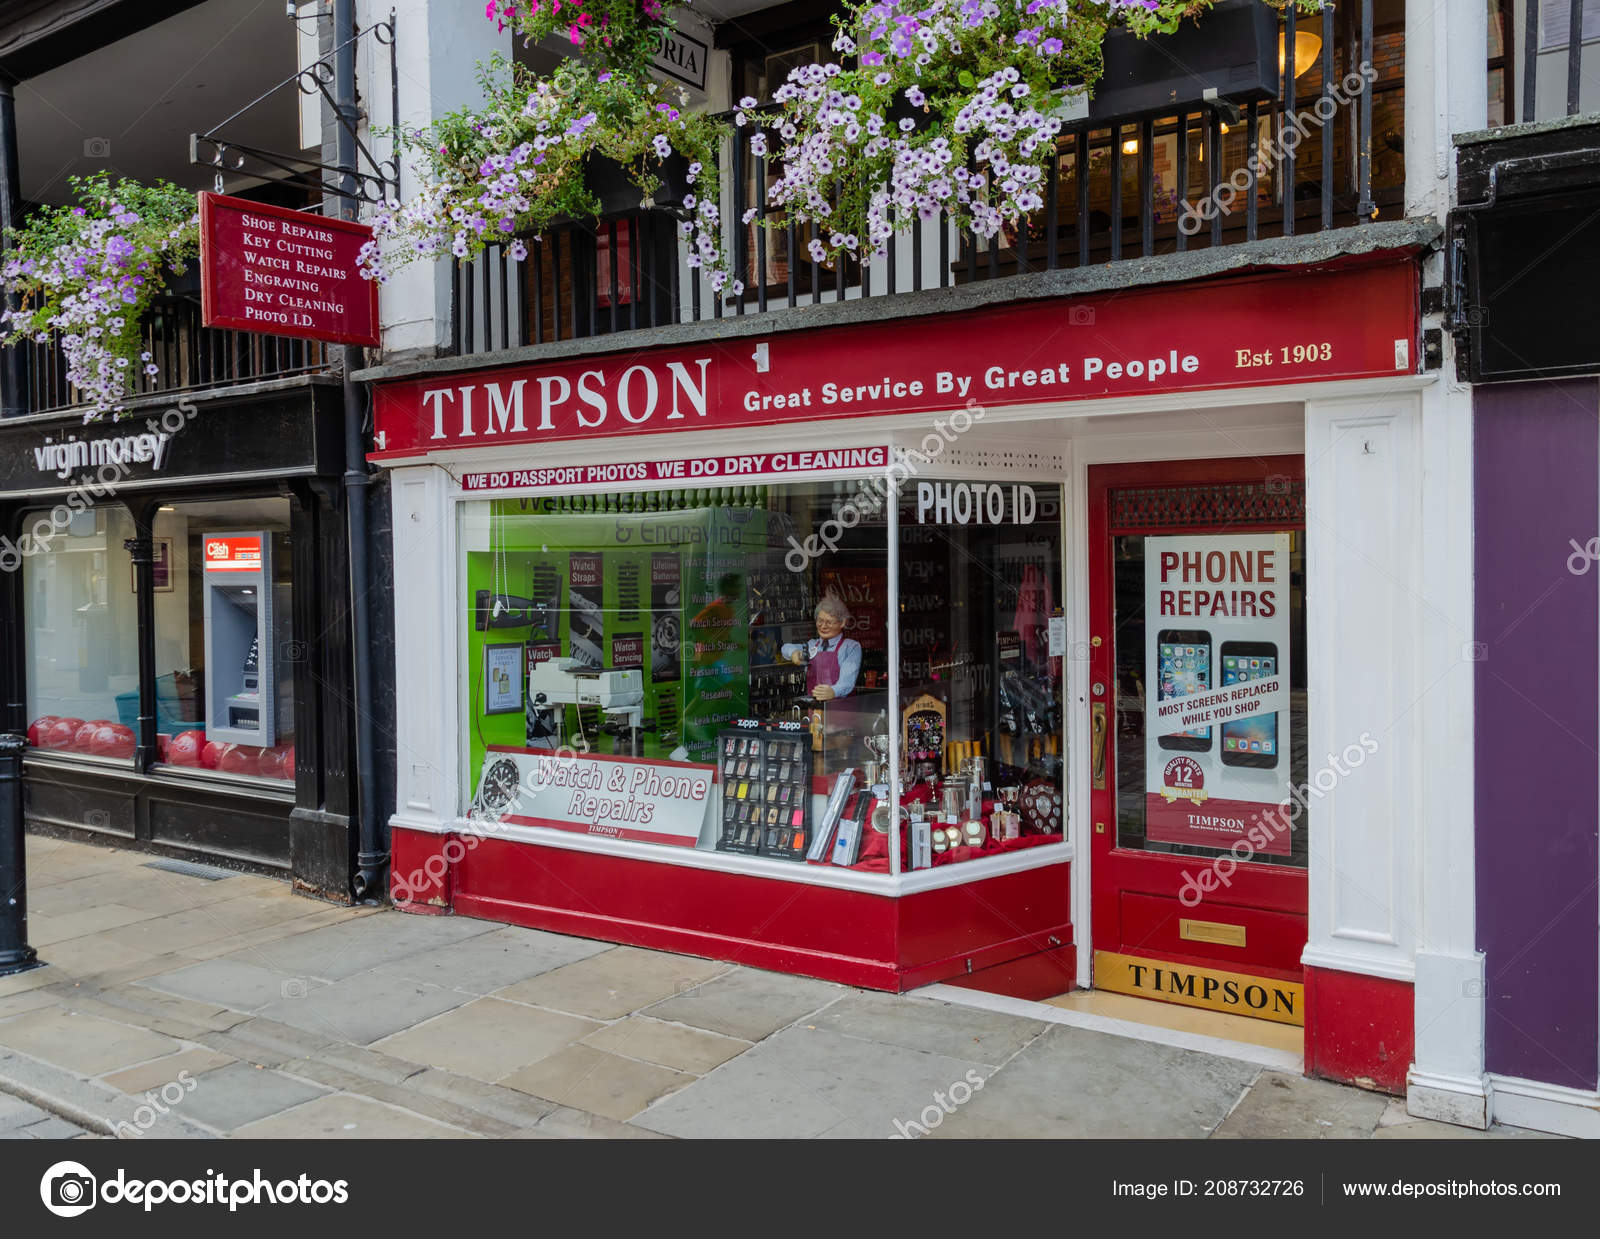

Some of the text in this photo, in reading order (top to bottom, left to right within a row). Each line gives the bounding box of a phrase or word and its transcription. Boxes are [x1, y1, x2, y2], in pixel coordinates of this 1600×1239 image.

[1235, 342, 1333, 368] Est 1903
[744, 350, 1200, 412] Great Service By Great People
[422, 358, 712, 440] TIMPSON
[34, 432, 169, 479] virgin money
[656, 447, 885, 478] WE DO DRY CLEANING
[467, 463, 648, 489] WE DO PASSPORT PHOTOS
[917, 482, 1004, 525] PHOTO
[1011, 485, 1036, 525] ID
[615, 517, 742, 548] & Engraving
[207, 542, 229, 556] Cash
[572, 561, 596, 571] Watch
[572, 573, 596, 584] Straps
[1160, 550, 1275, 583] PHONE
[1160, 590, 1276, 617] REPAIRS
[614, 641, 636, 652] Watch
[614, 653, 642, 664] Servicing
[1158, 681, 1279, 717] MOST SCREENS REPLACED
[1182, 700, 1261, 726] WHILE YOU SHOP
[537, 759, 707, 801] Watch & Phone
[1175, 766, 1192, 783] 12
[568, 790, 655, 825] Repairs
[588, 825, 618, 834] TIMPSON
[1187, 814, 1244, 829] TIMPSON
[1128, 964, 1296, 1015] TIMPSON
